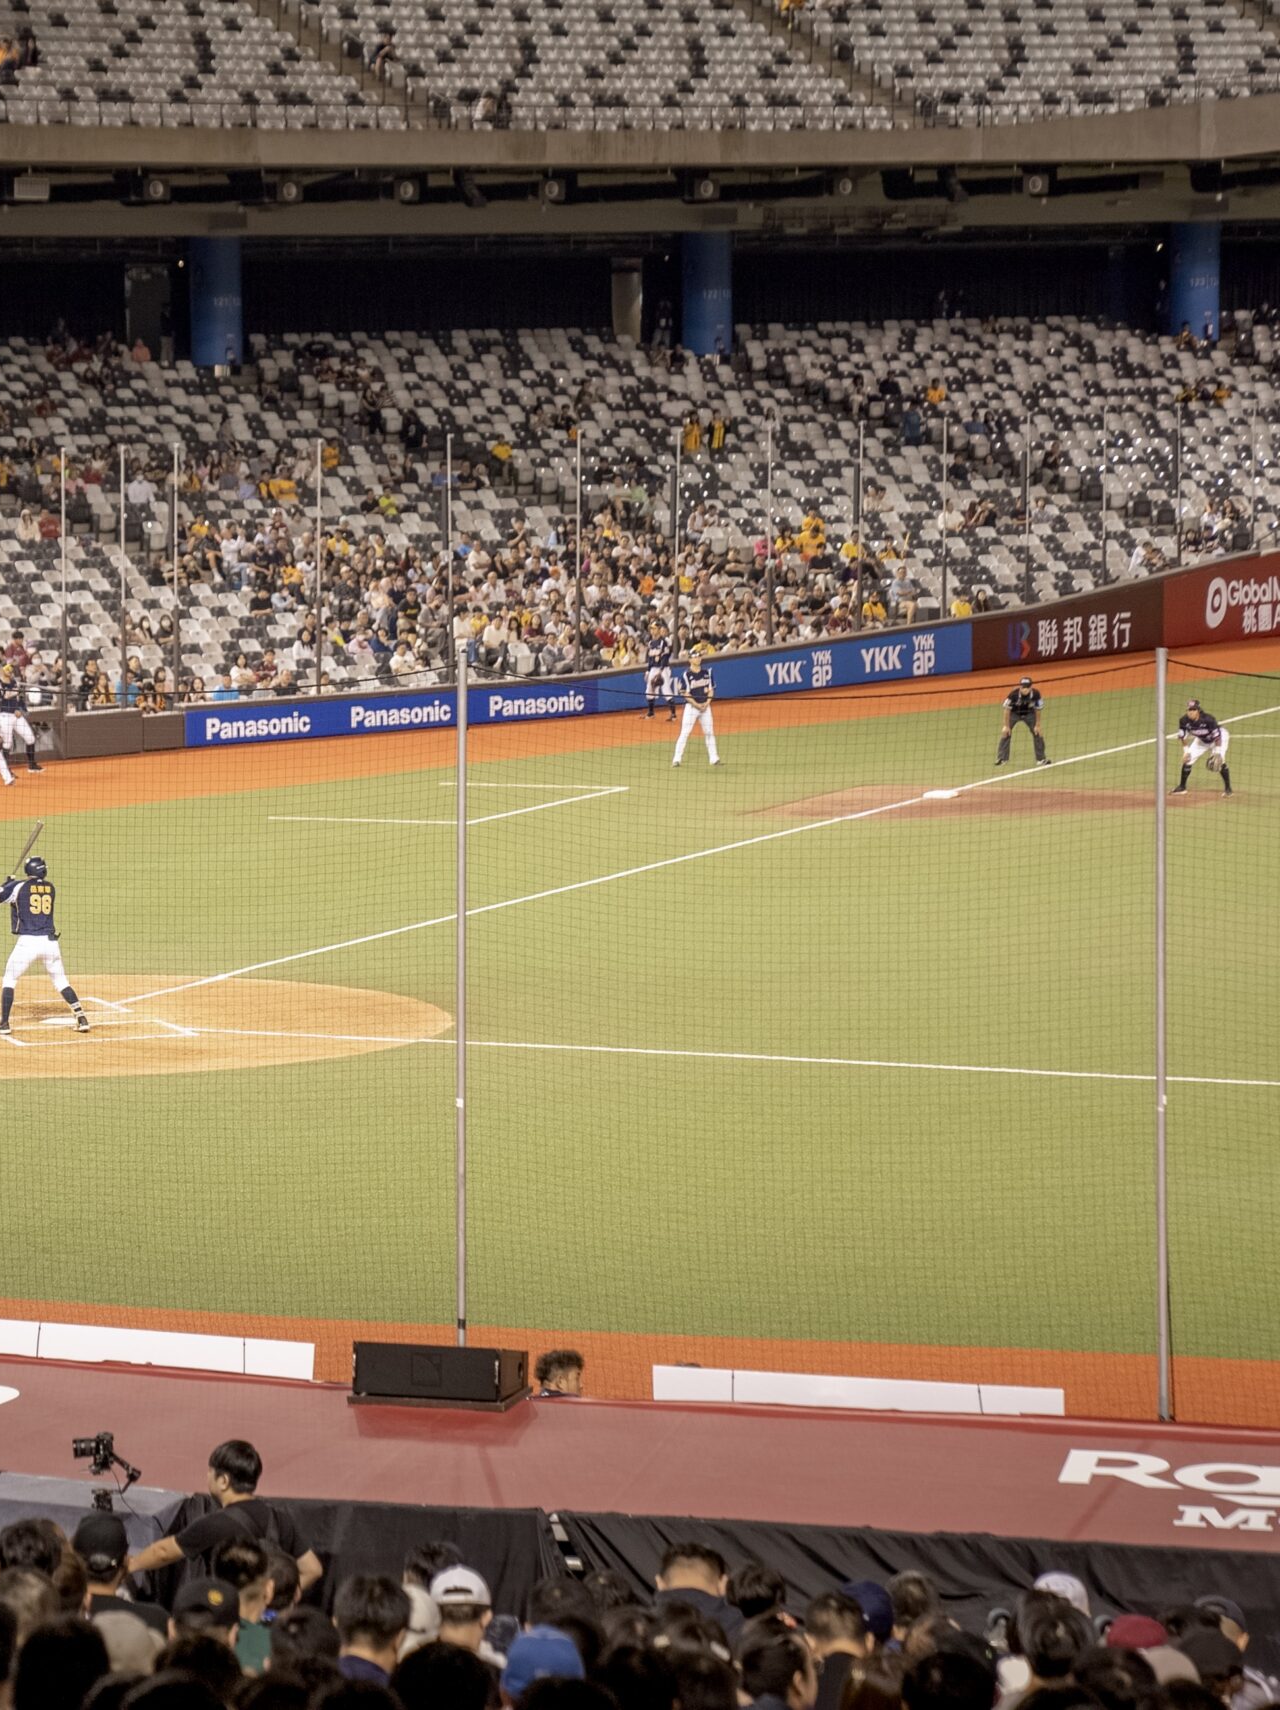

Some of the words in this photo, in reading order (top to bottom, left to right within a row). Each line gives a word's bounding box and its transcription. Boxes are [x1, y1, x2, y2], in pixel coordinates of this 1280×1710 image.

[913, 633, 935, 651] YKK
[1037, 611, 1132, 657] 聯邦銀行
[811, 650, 832, 665] YKK
[350, 700, 451, 729] Panasonic
[488, 690, 584, 718] Panasonic
[205, 712, 311, 740] Panasonic
[1058, 1449, 1280, 1495] Ra
[1173, 1504, 1280, 1532] M
